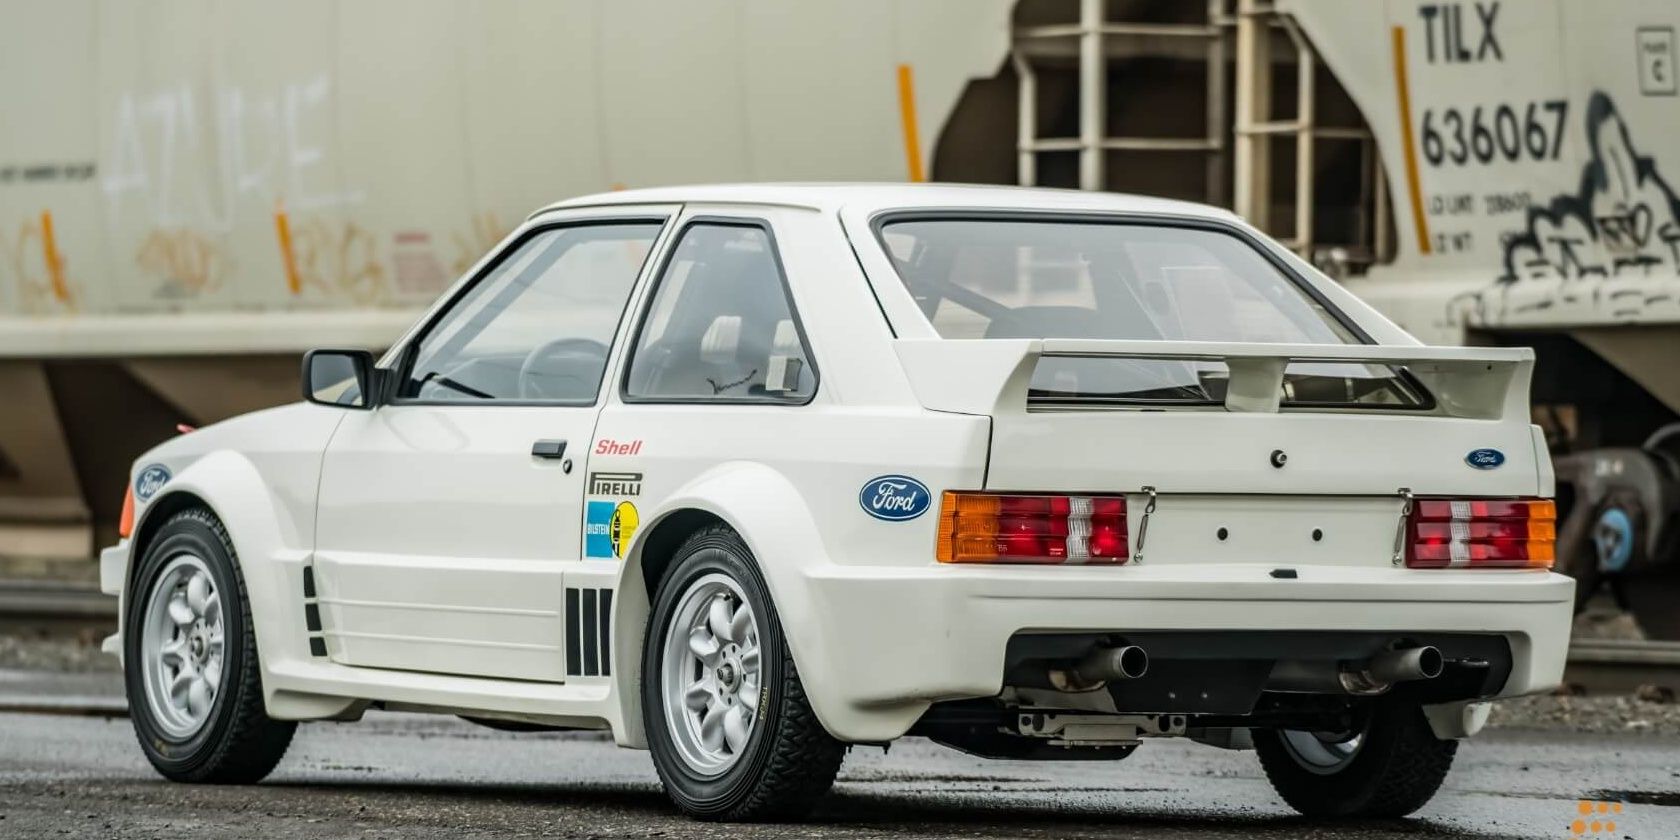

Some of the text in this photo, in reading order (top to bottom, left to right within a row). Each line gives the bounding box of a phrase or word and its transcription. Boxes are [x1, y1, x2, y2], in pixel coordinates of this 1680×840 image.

[1419, 2, 1503, 63] TILX
[1421, 101, 1568, 167] 636067
[595, 439, 642, 455] Shell
[589, 472, 643, 496] PIRELLI
[872, 481, 917, 511] Ford
